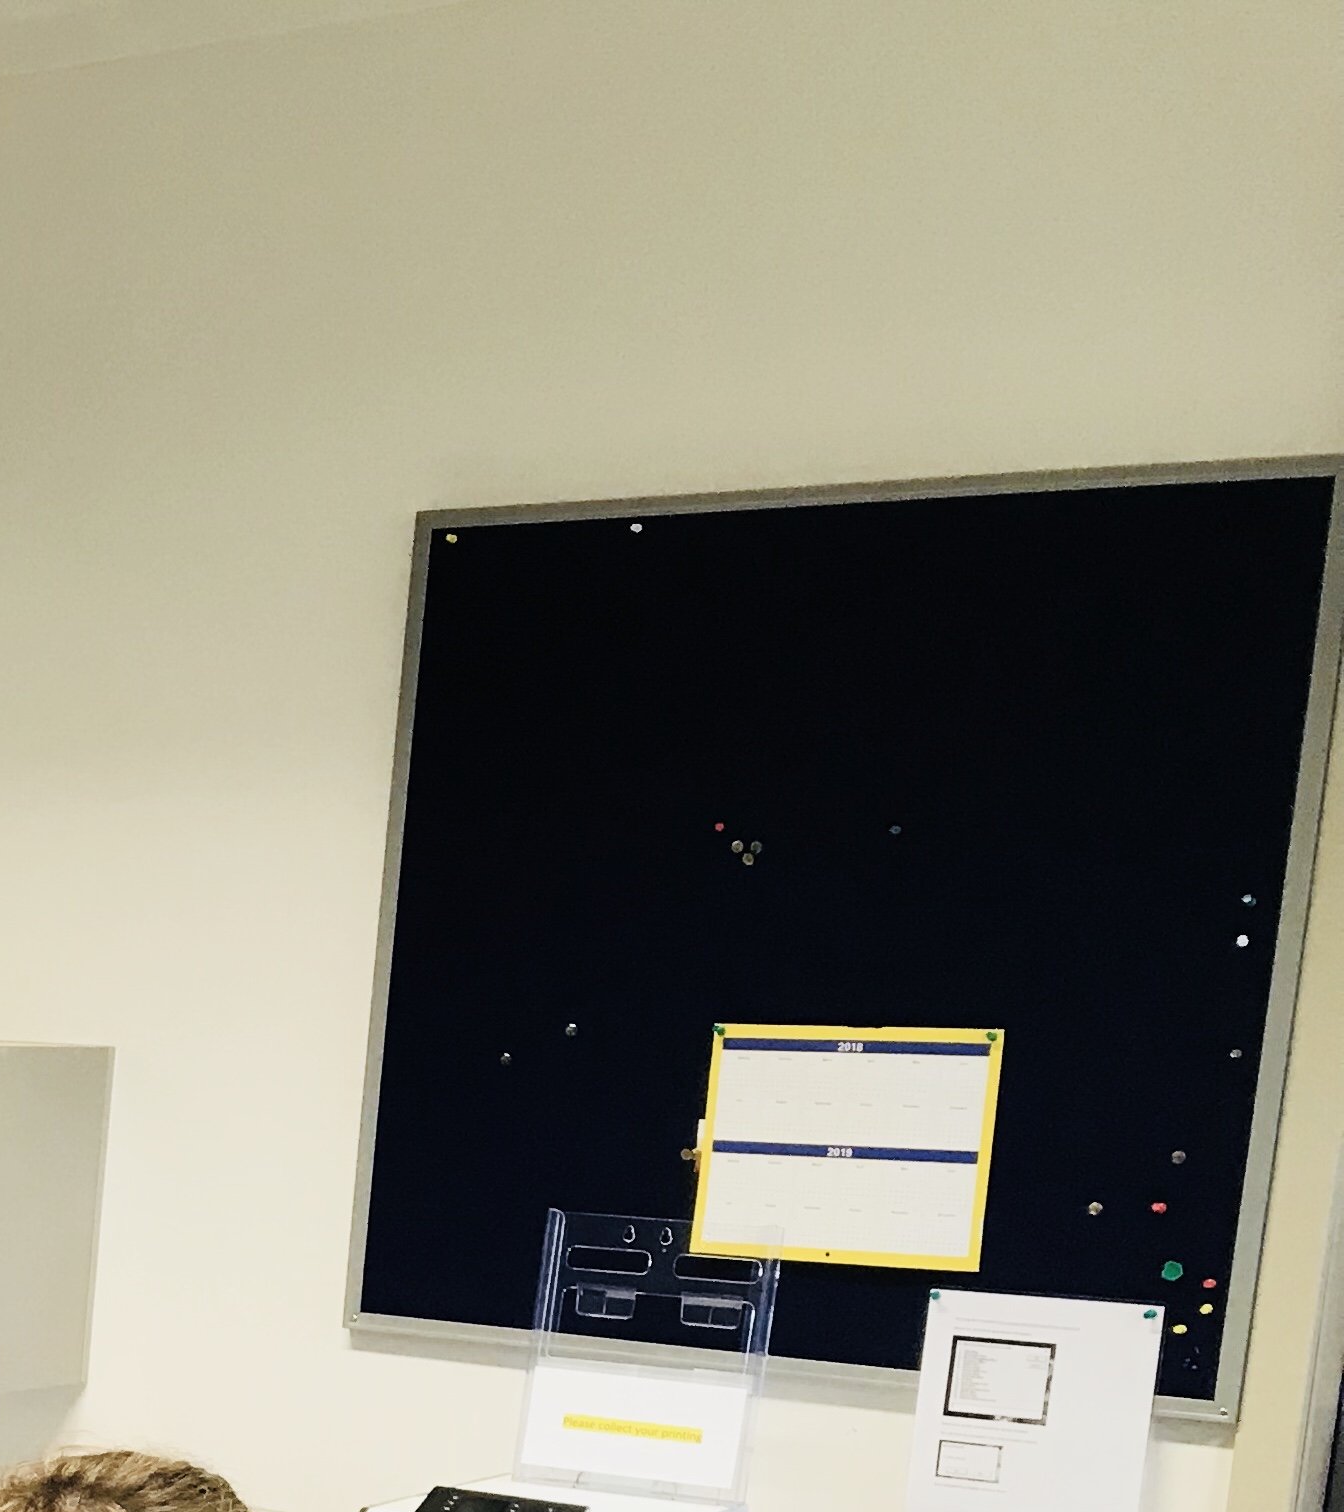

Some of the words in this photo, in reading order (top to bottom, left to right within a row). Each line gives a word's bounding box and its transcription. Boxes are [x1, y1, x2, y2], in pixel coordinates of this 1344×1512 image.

[837, 1041, 864, 1052] 2018
[827, 1146, 853, 1158] 2019
[563, 1416, 595, 1430] Please
[598, 1421, 632, 1433] collect
[635, 1426, 658, 1437] your
[661, 1429, 702, 1443] printing
